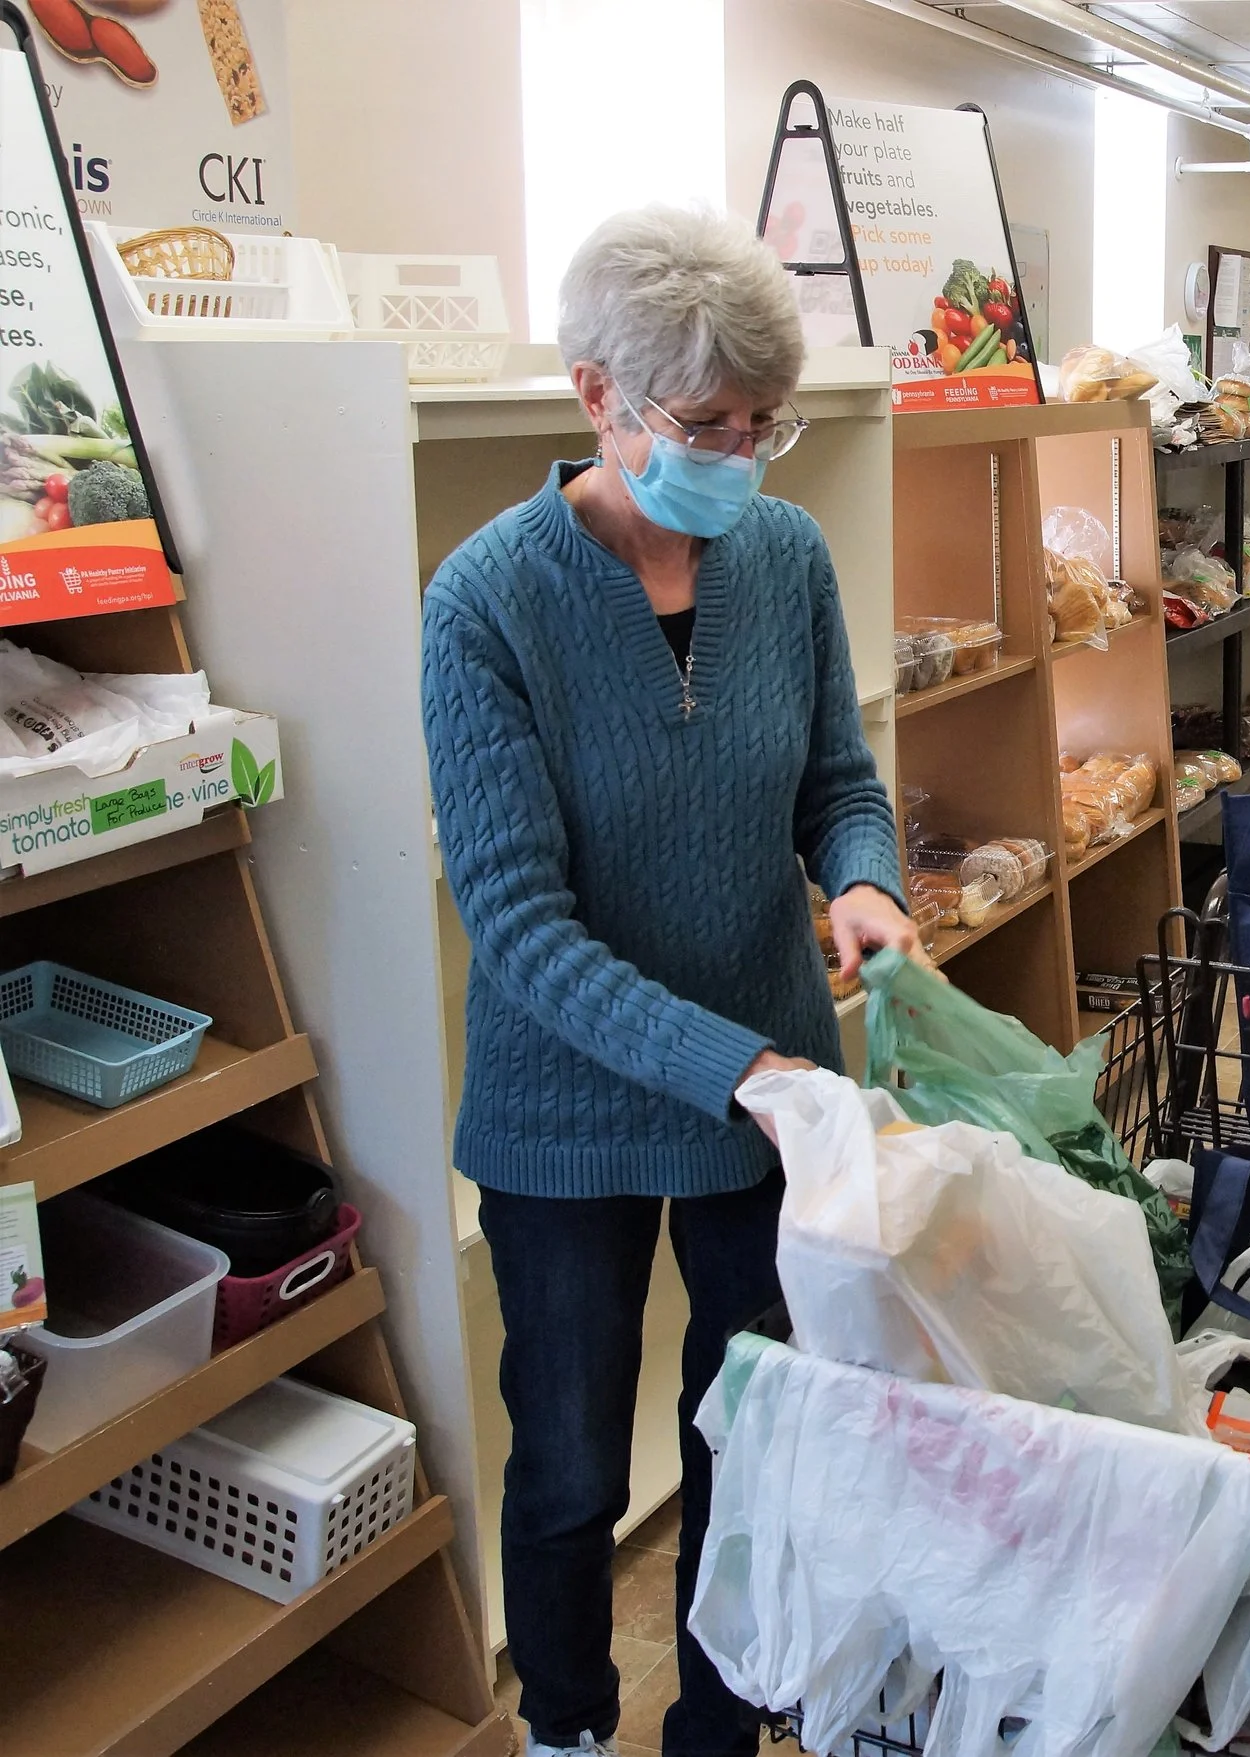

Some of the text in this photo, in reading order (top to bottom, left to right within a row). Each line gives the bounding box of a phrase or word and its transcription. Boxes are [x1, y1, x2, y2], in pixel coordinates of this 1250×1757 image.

[830, 109, 905, 133] Make half
[835, 140, 912, 163] your plate
[198, 153, 266, 205] CKI
[840, 165, 915, 188] fruits and
[192, 209, 283, 226] Circle K International
[846, 198, 938, 219] vegetables.
[850, 224, 932, 244] Pick some
[857, 254, 934, 277] up today!
[912, 357, 944, 369] BANK
[944, 388, 978, 396] FEEDING
[180, 752, 224, 770] intergrow
[96, 788, 156, 812] Large Bags
[12, 818, 91, 855] tomato
[191, 777, 229, 802] vine
[107, 803, 166, 826] For Produce
